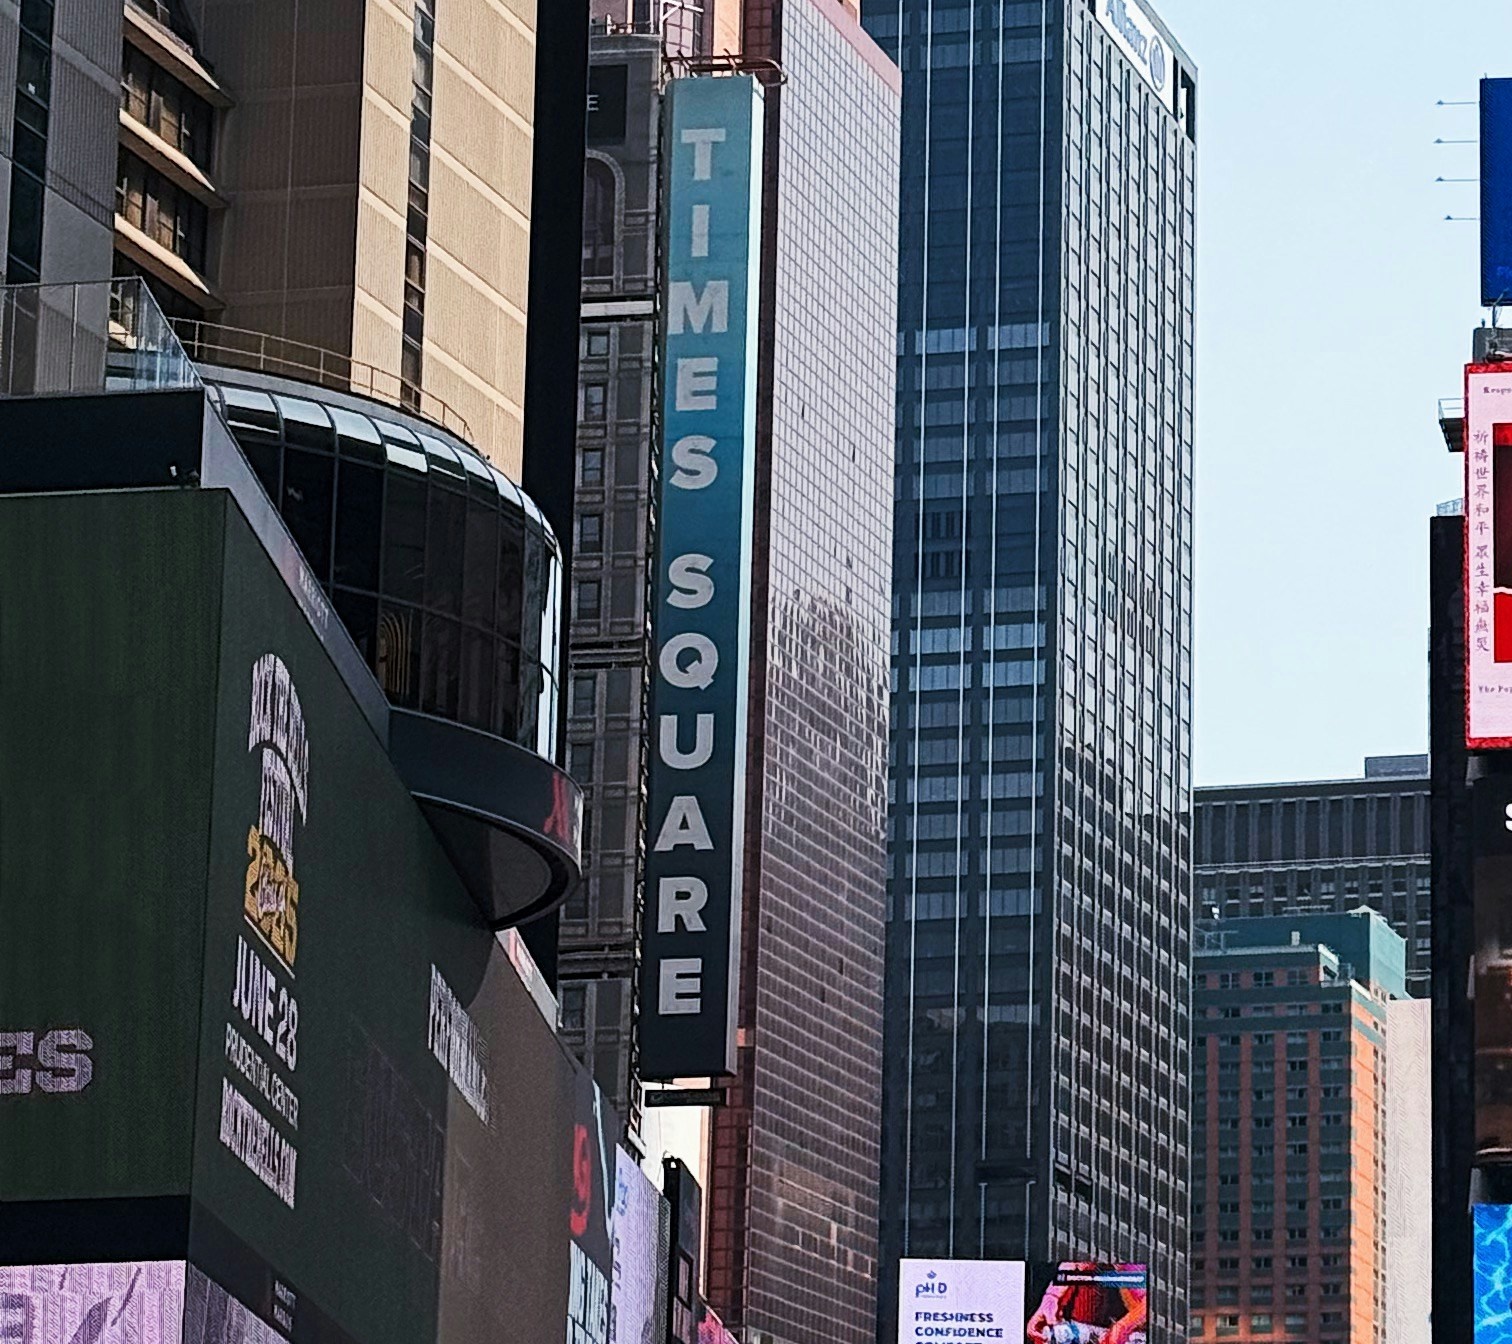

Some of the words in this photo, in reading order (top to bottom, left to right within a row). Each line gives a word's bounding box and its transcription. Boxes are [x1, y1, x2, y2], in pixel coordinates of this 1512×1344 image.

[668, 128, 730, 490] TIMES
[654, 554, 719, 1015] SQUARE
[233, 934, 276, 1046] JUNE
[276, 987, 298, 1072] 28
[225, 1021, 271, 1100] PRUDENTIAL
[915, 1311, 994, 1322] FRESHNESS
[915, 1327, 1004, 1338] CONFIDENCE
